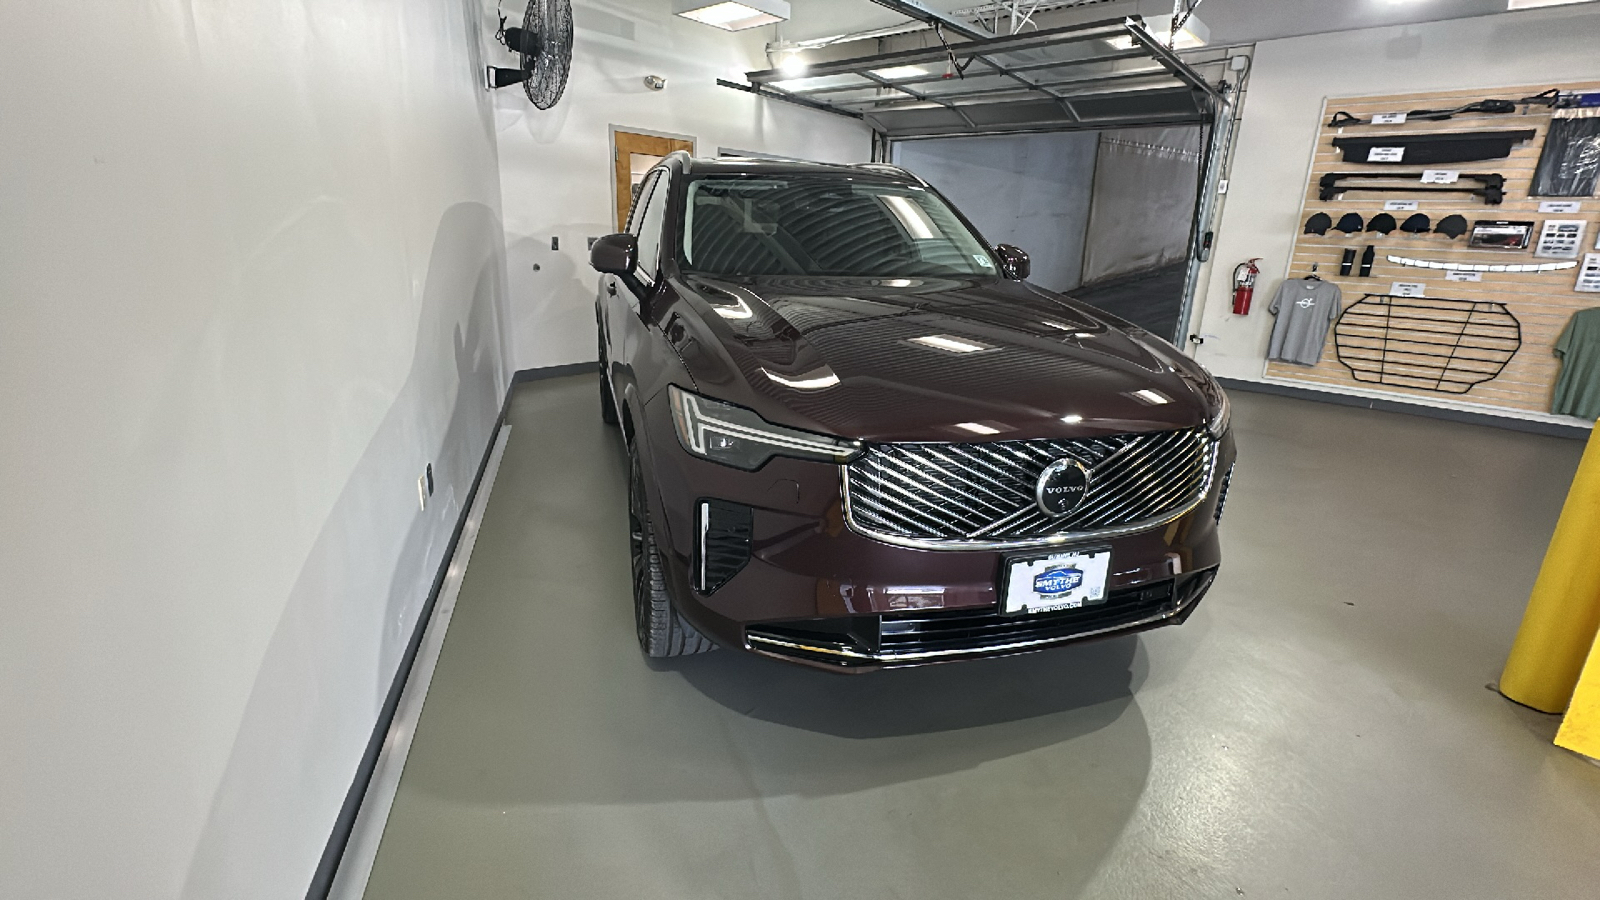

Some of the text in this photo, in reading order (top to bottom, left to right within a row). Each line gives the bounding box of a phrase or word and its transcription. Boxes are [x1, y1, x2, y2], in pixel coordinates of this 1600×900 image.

[1046, 486, 1084, 494] VOLVO
[1035, 576, 1081, 588] SMYTHE
[1045, 583, 1072, 591] VOLVO
